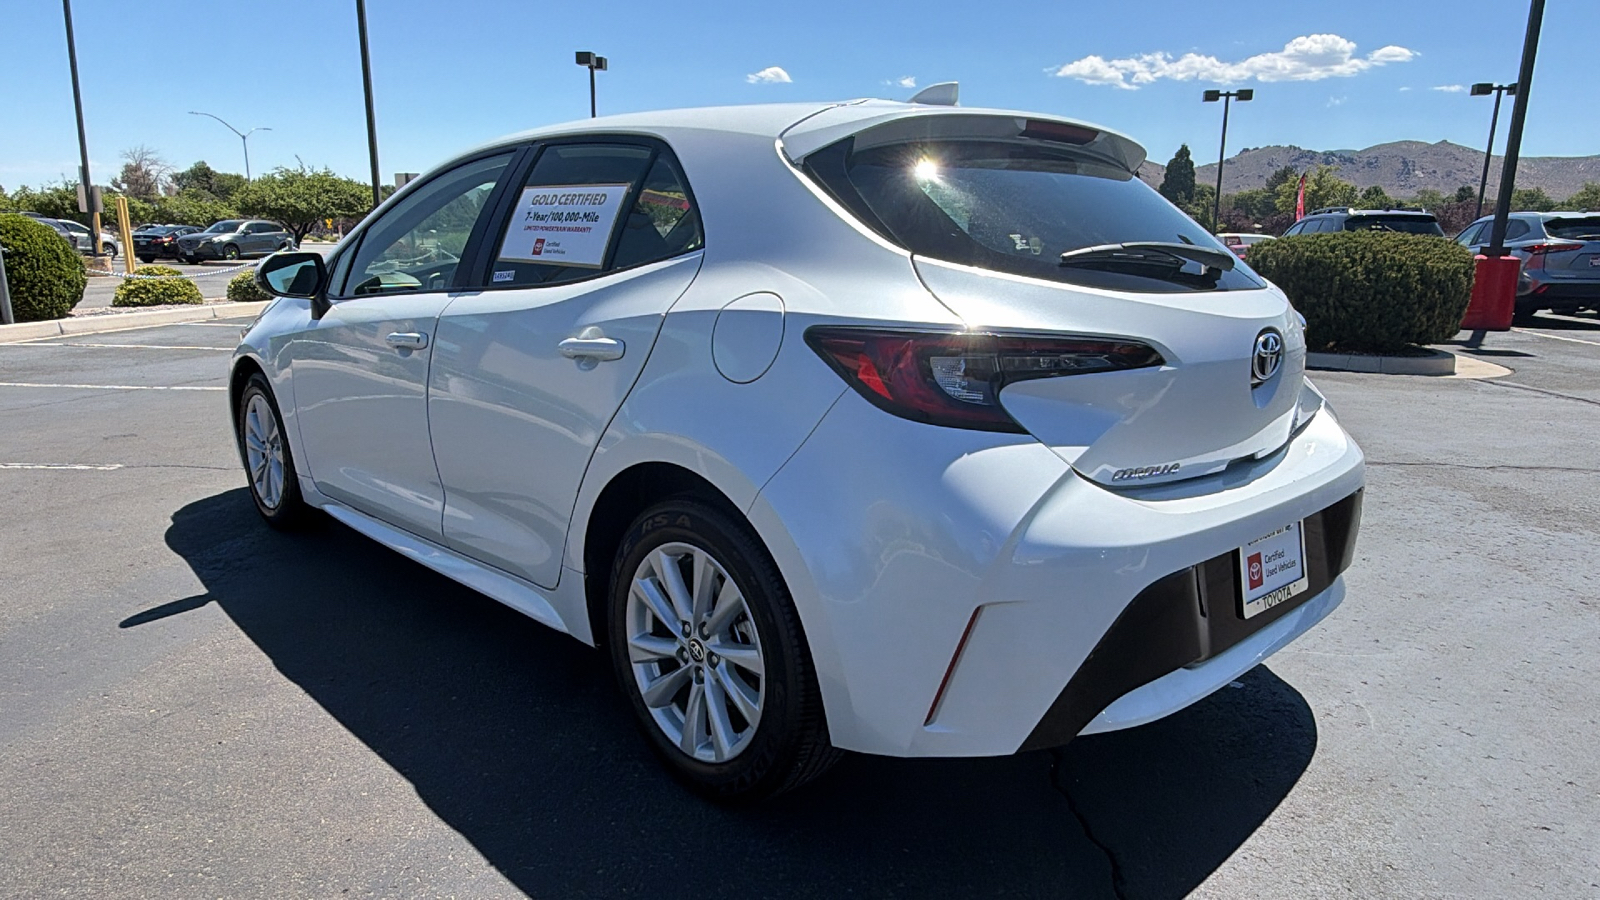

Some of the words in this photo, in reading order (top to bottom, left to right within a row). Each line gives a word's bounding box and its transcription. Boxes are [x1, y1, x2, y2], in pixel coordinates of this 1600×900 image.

[532, 195, 557, 205] GOLD
[558, 194, 607, 205] CERTIFIED
[525, 211, 600, 223] 7-Year/100,000-Mile
[1112, 462, 1181, 482] COROLLA
[1265, 549, 1285, 563] Certified
[1265, 565, 1278, 577] Used
[1278, 558, 1297, 573] Vehicles
[1263, 587, 1292, 609] TOYOTA
